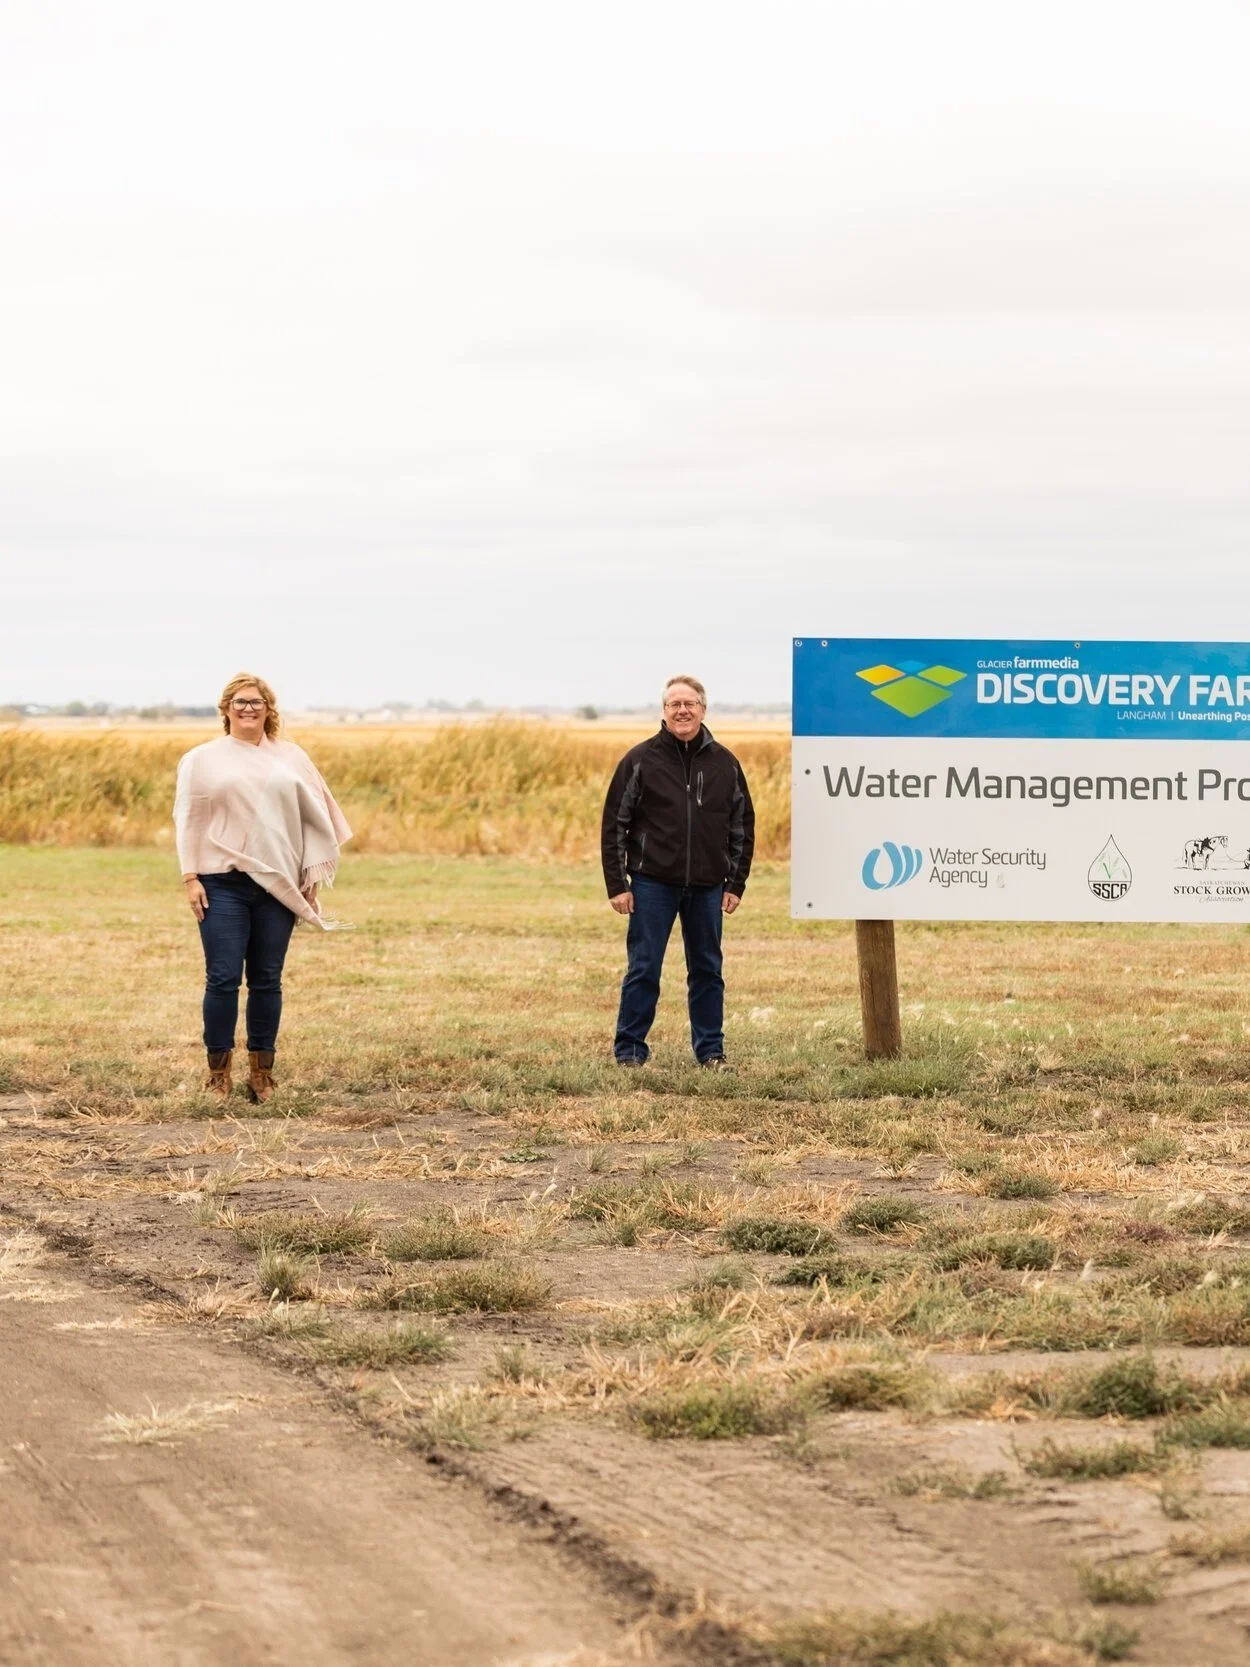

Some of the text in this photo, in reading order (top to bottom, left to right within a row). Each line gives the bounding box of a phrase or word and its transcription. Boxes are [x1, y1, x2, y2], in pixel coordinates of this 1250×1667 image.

[976, 656, 1080, 669] GLACIER farmmedia
[976, 673, 1181, 705] DISCOVERY
[1117, 711, 1166, 721] LANGHAM
[1178, 711, 1233, 722] Unearthing
[822, 765, 937, 798] Water
[945, 766, 1188, 807] Management
[929, 847, 1047, 870] Water Security
[929, 866, 988, 888] Agency
[1092, 883, 1128, 899] SSCA
[1173, 885, 1212, 895] STOCK
